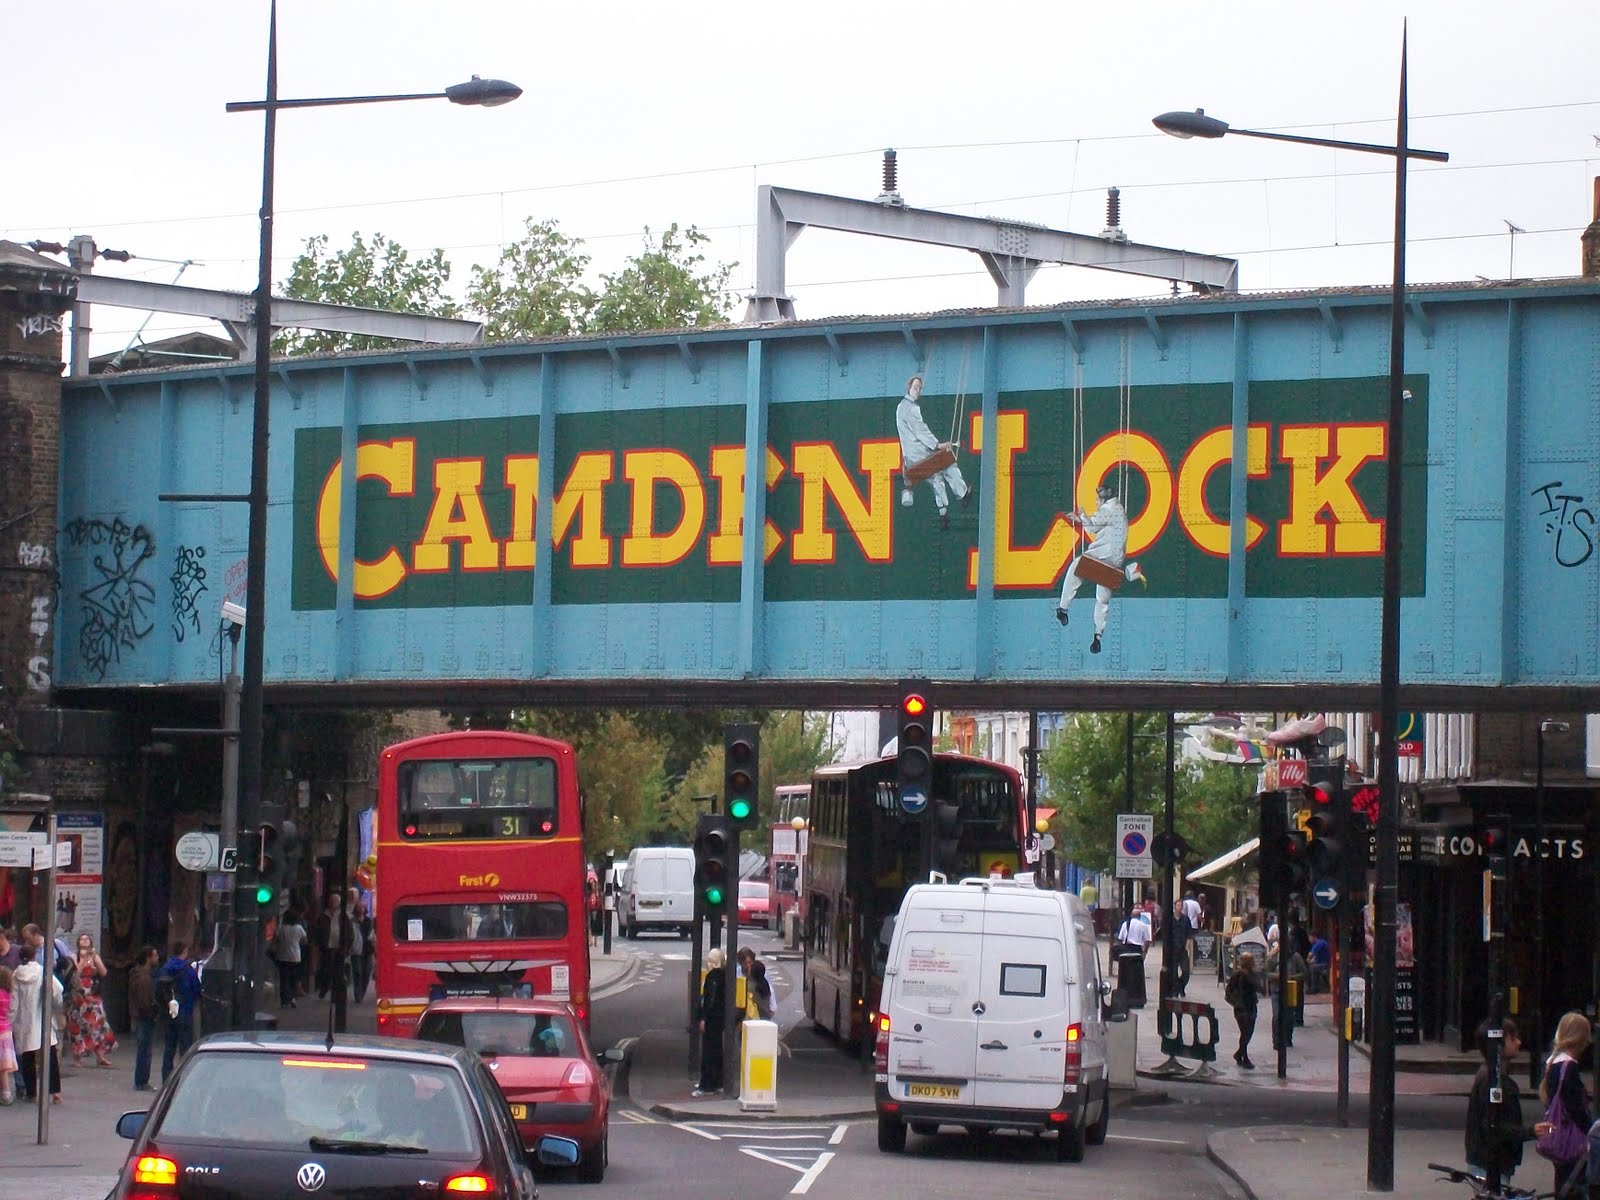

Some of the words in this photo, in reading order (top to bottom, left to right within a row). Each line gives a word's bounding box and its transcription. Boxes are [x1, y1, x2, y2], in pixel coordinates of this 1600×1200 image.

[315, 435, 902, 600] CAMDEN
[966, 407, 1389, 591] LOCK
[1398, 742, 1414, 751] OLD
[1282, 764, 1304, 784] illy
[502, 816, 520, 836] 31
[459, 875, 484, 887] First
[911, 1085, 939, 1097] DK07
[939, 1086, 960, 1098] SVN
